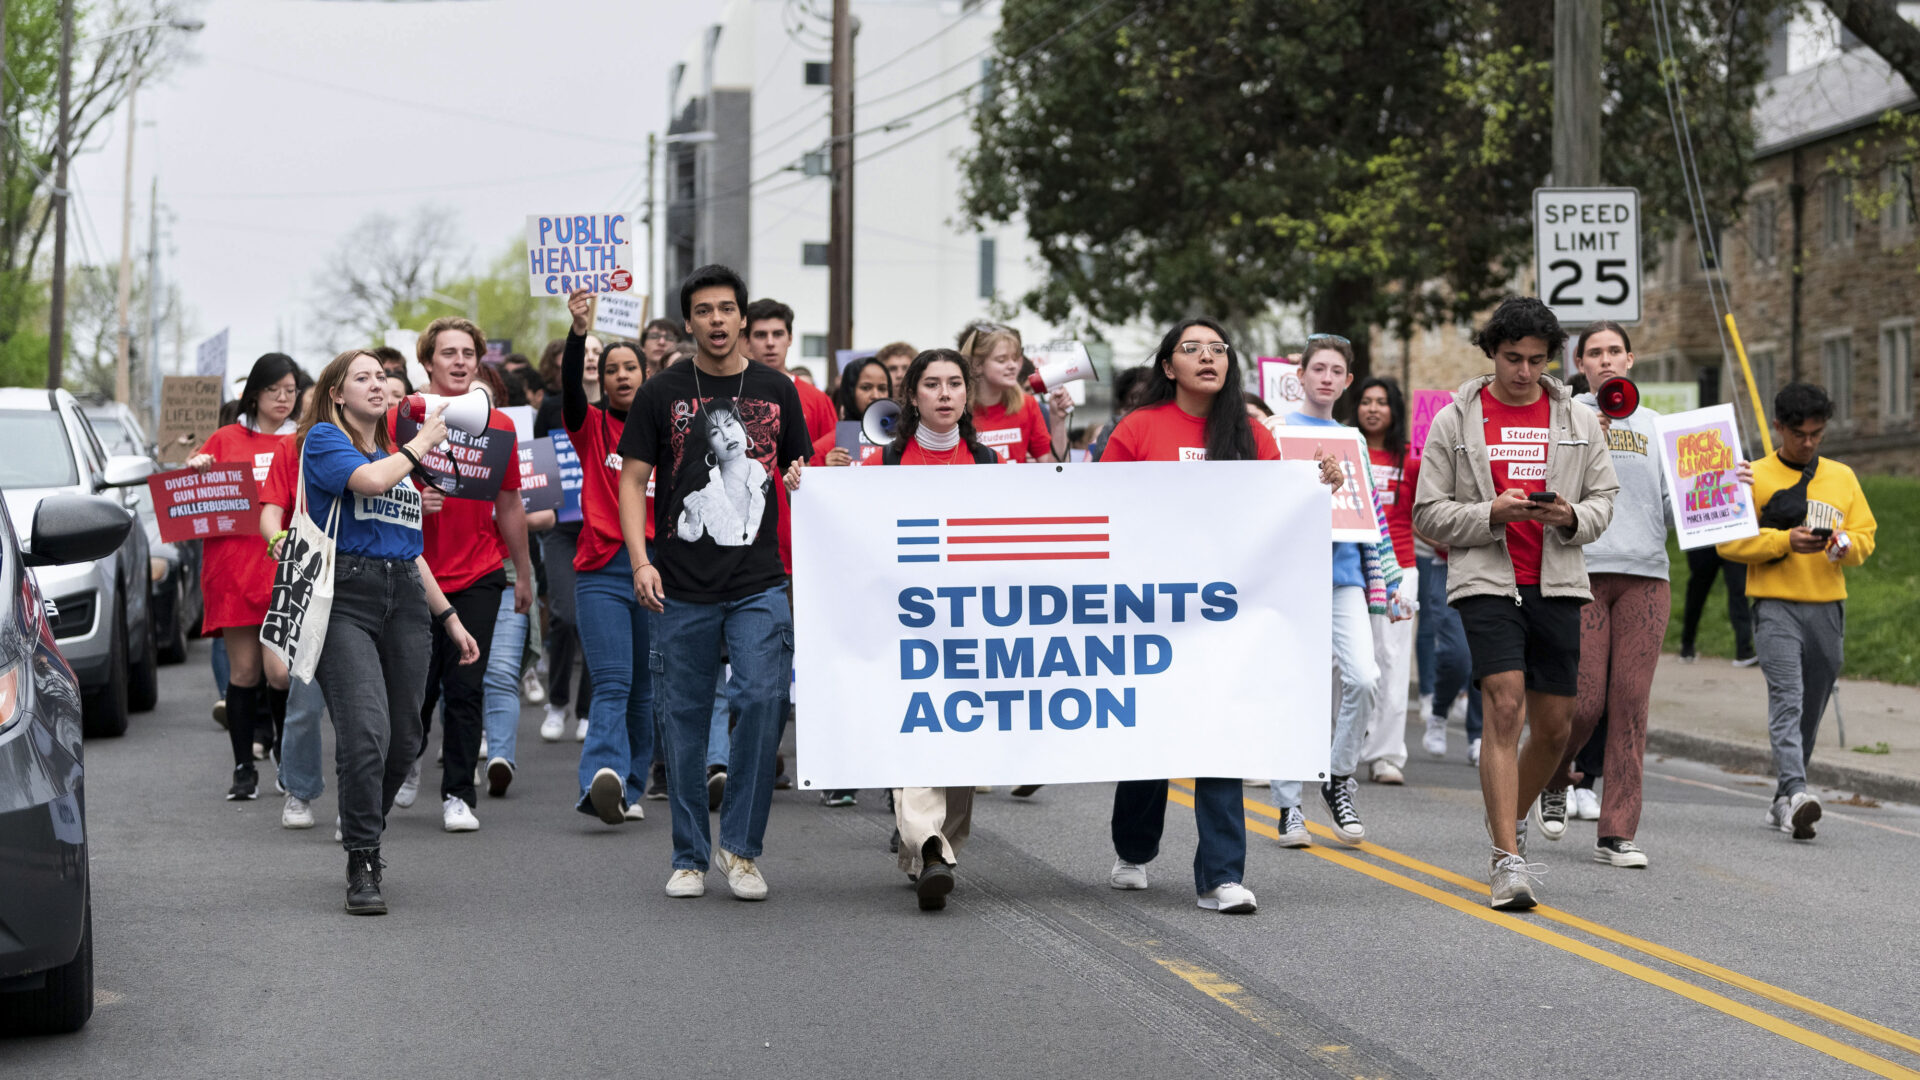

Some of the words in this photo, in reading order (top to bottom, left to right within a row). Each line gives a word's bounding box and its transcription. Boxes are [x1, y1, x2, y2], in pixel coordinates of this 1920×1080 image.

[1545, 204, 1629, 224] SPEED
[1555, 231, 1619, 251] LIMIT
[1548, 259, 1630, 306] 25
[600, 296, 640, 309] PROTECT
[597, 315, 615, 326] NOT
[616, 318, 639, 329] GUNS
[608, 307, 630, 318] KIDS
[165, 408, 193, 422] LIFE
[1507, 430, 1550, 440] Studen
[1678, 429, 1723, 458] PACK
[467, 449, 482, 463] OF
[518, 448, 534, 462] HE
[1490, 447, 1540, 457] Demand
[422, 454, 453, 473] RICAN
[519, 463, 532, 476] OF
[164, 474, 199, 491] DIVEST
[201, 471, 227, 484] FROM
[227, 470, 243, 482] THE
[520, 473, 547, 490] OUTH
[1695, 470, 1725, 490] NOT
[173, 489, 195, 503] GUN
[395, 488, 420, 507] OUR
[1686, 483, 1739, 511] HEAT
[169, 498, 250, 518] #KILLERBUSINESS
[363, 497, 401, 519] LIVES
[897, 581, 1239, 628] STUDENTS
[900, 634, 1173, 680] DEMAND
[900, 687, 1136, 733] ACTION
